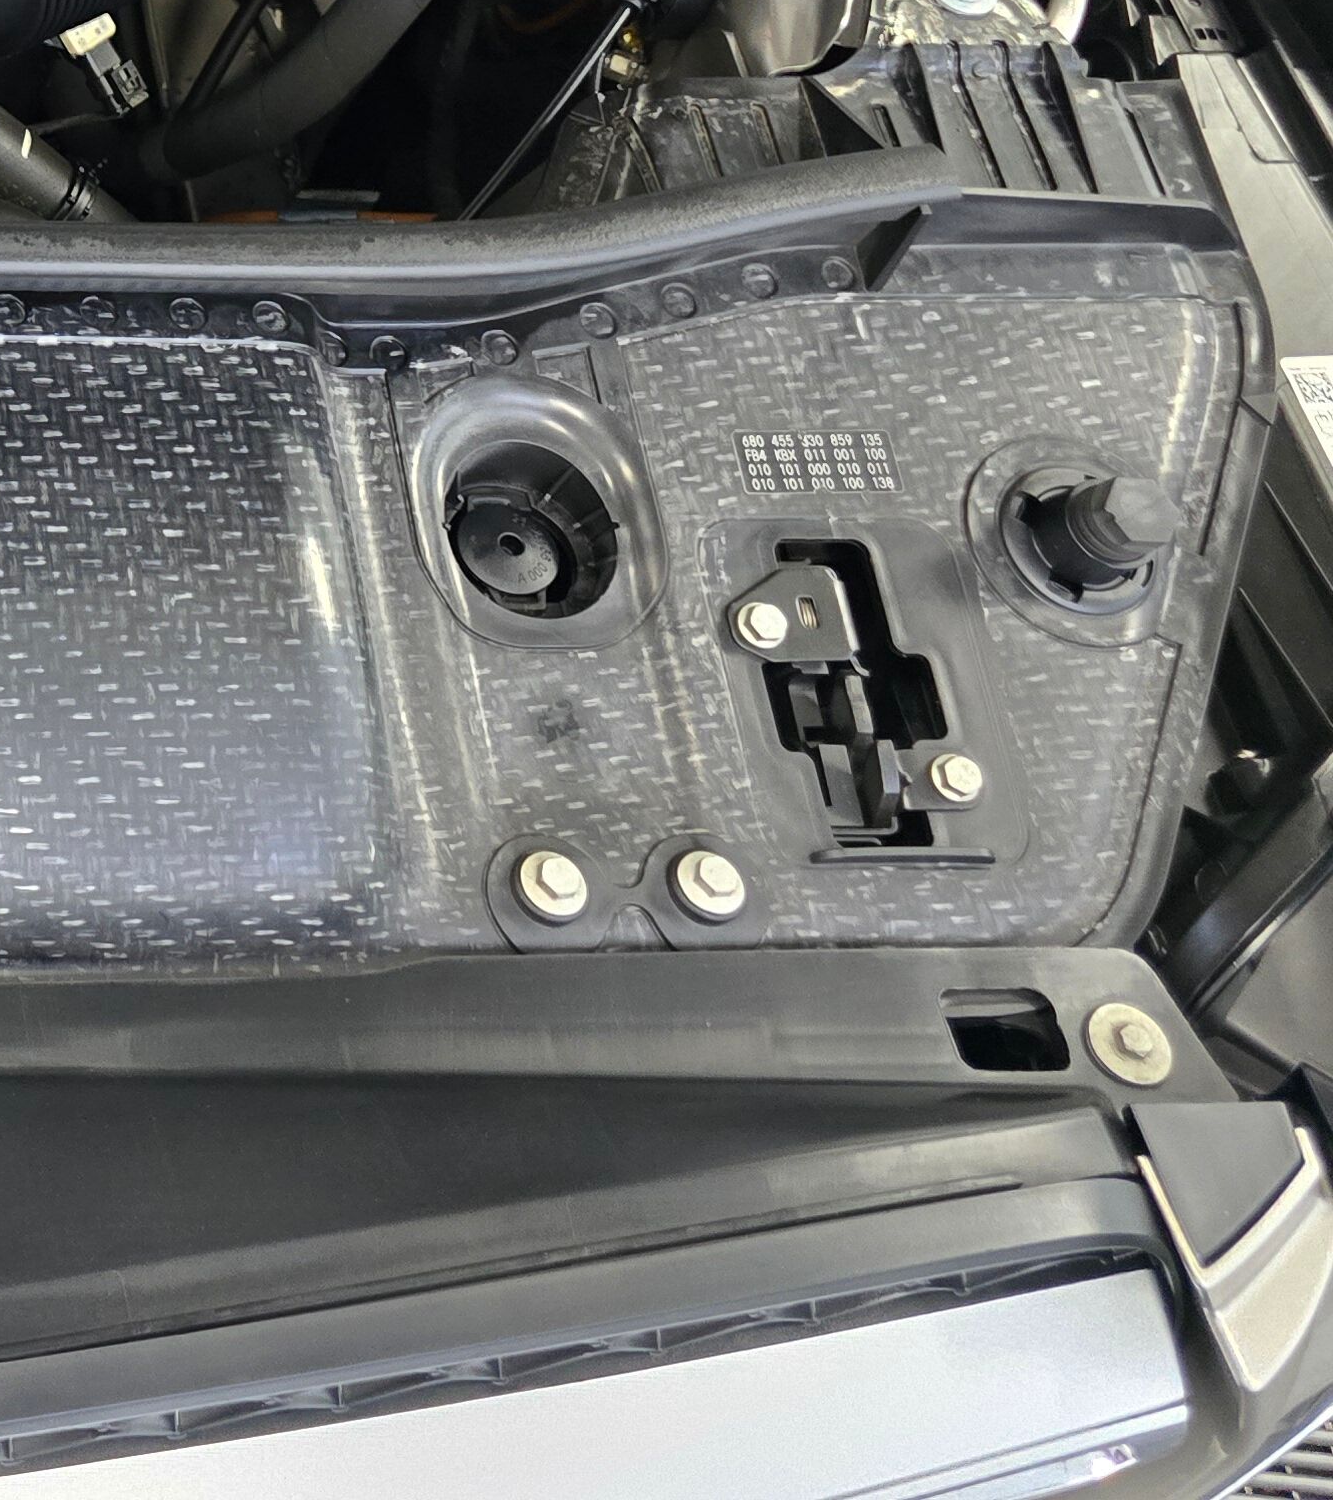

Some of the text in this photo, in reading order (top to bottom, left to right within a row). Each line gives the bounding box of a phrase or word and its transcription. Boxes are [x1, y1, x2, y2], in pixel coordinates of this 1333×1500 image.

[742, 435, 764, 447] 680
[771, 435, 794, 447] 455
[830, 434, 852, 446] 859
[861, 434, 882, 446] 135
[745, 450, 767, 462] FB4
[804, 449, 826, 461] 011
[834, 449, 856, 461] 001
[865, 449, 886, 460] 100
[748, 462, 890, 476] 010 101 000 010 011
[752, 477, 895, 491] 010 101 010 100 138
[528, 562, 548, 582] 000
